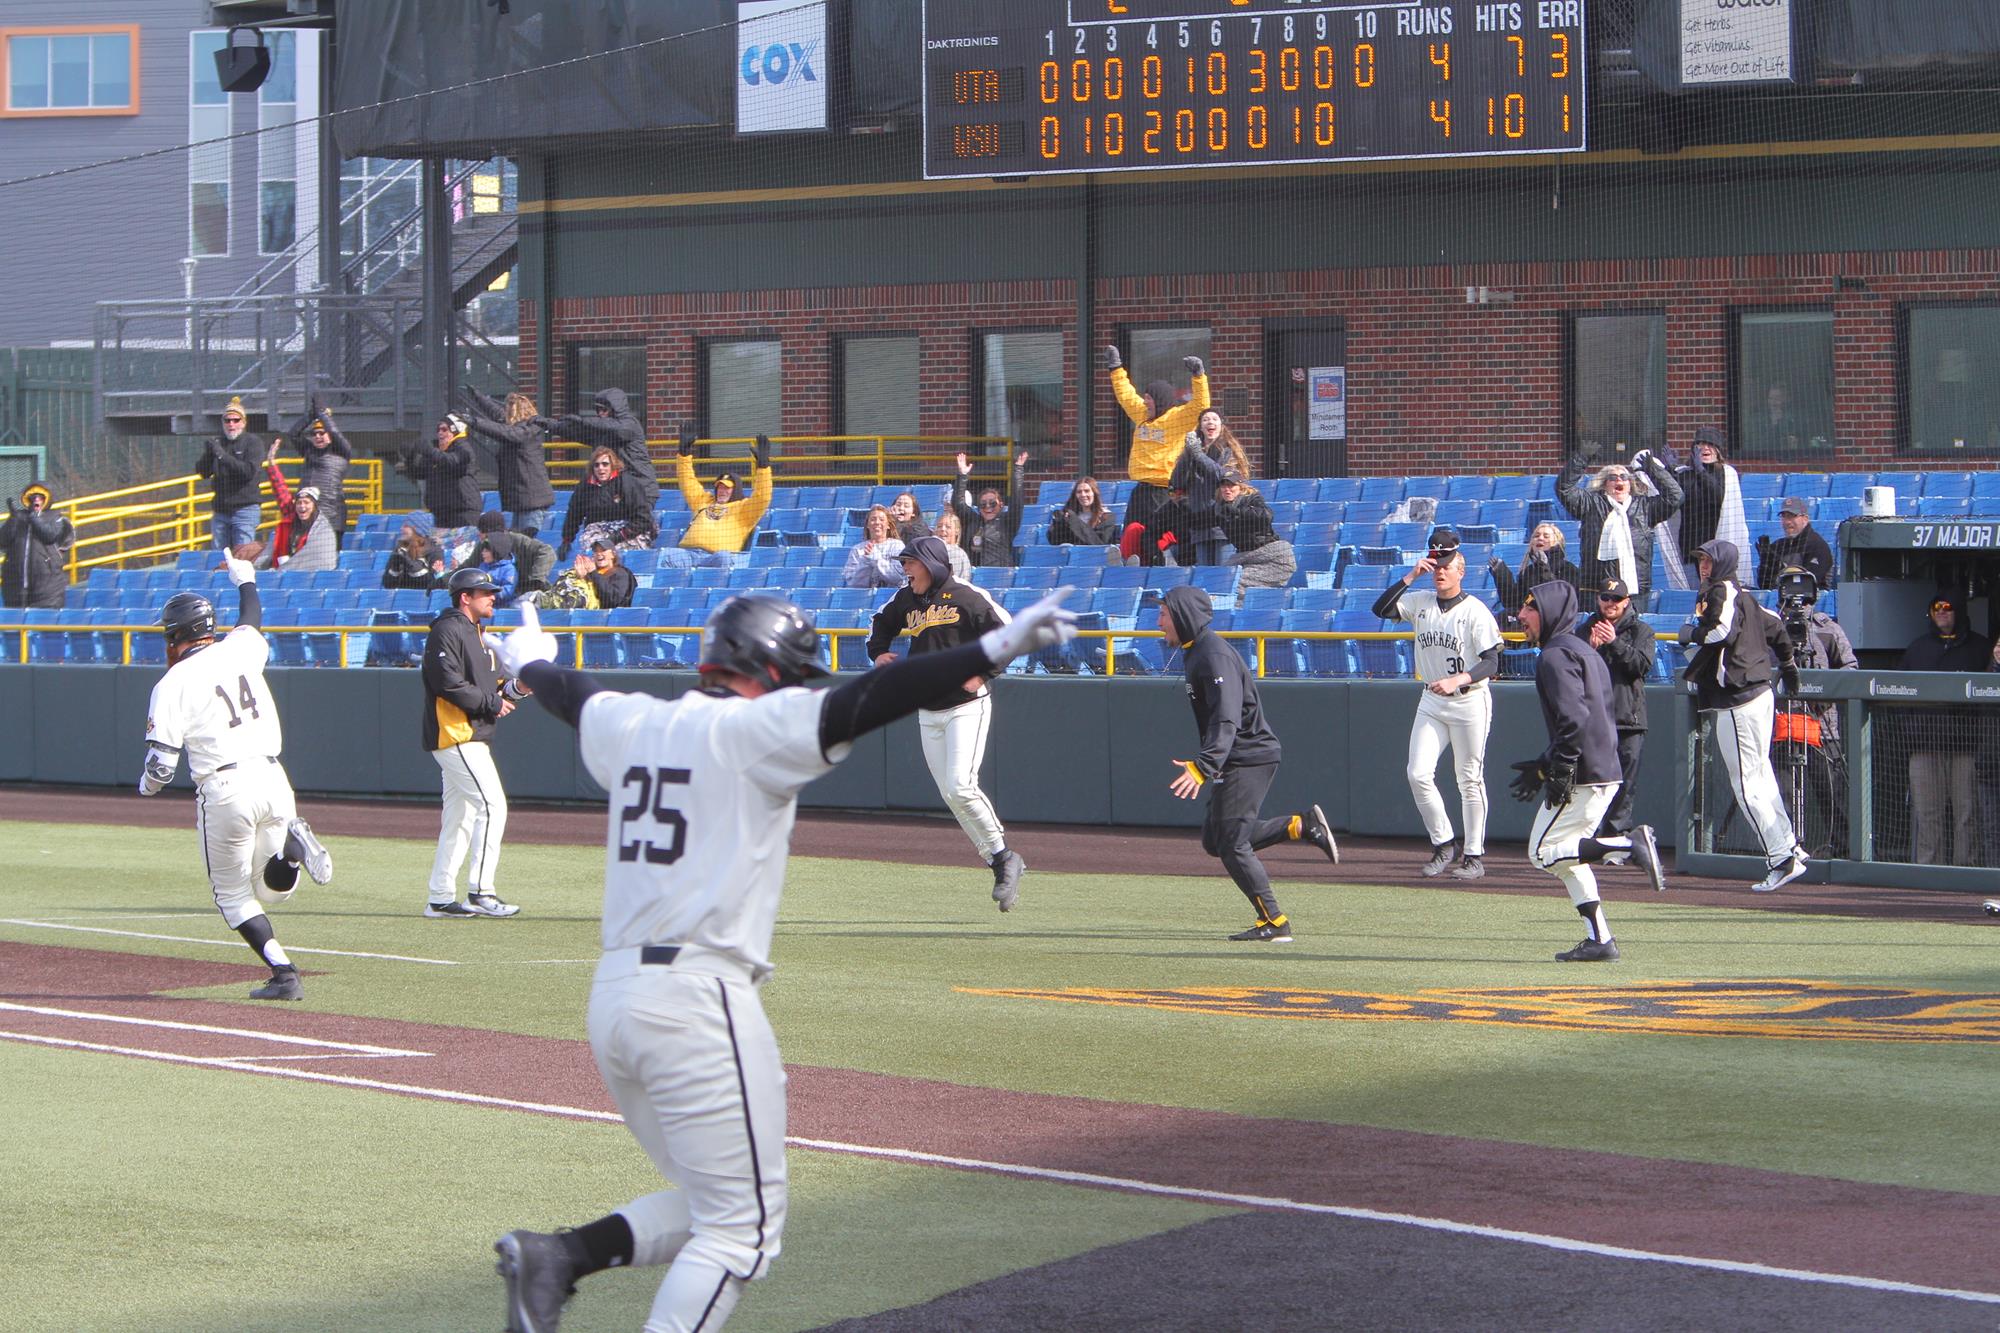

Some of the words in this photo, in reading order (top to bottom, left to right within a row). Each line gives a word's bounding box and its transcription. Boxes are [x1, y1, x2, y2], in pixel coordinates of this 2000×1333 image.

[1045, 30, 1054, 56] 1
[1074, 28, 1086, 54] 2
[1106, 26, 1117, 51] 3
[1146, 24, 1157, 49] 4
[1178, 22, 1190, 48] 5
[1210, 20, 1222, 46] 6
[1251, 18, 1262, 44] 7
[1283, 16, 1294, 42] 8
[1316, 14, 1326, 40] 9
[1355, 11, 1377, 38] 10
[1397, 6, 1452, 36] RUNS
[1476, 3, 1522, 32] HITS
[1538, 0, 1579, 29] ERR
[1685, 19, 1701, 32] Get
[927, 36, 999, 50] DAKTRONICS
[1685, 41, 1701, 54] Get
[741, 39, 817, 86] COX
[953, 69, 999, 104] UTA
[1040, 61, 1059, 104] 0
[1072, 59, 1091, 102] 0
[1104, 57, 1123, 100] 0
[1142, 55, 1162, 98] 0
[1187, 57, 1194, 93] 1
[1207, 52, 1227, 95] 0
[1249, 49, 1266, 93] 3
[1280, 48, 1300, 91] 0
[1314, 46, 1333, 89] 0
[1355, 43, 1374, 87] 0
[1430, 42, 1449, 81] 4
[1506, 36, 1523, 77] 7
[1551, 33, 1568, 78] 3
[1685, 64, 1701, 77] Get
[1704, 62, 1728, 75] More
[1730, 61, 1750, 74] Out
[1751, 57, 1763, 78] of
[953, 124, 1000, 158] WSU
[1040, 116, 1060, 158] 0
[1085, 117, 1092, 154] 1
[1104, 113, 1124, 155] 0
[1143, 111, 1162, 153] 2
[1175, 109, 1194, 152] 0
[1208, 107, 1227, 150] 0
[1248, 105, 1267, 149] 0
[1294, 106, 1301, 144] 1
[1315, 102, 1334, 146] 0
[1430, 99, 1450, 138] 4
[1488, 94, 1524, 138] 10
[1563, 94, 1569, 133] 1
[1912, 525, 1934, 547] 37
[1936, 525, 1992, 547] MAJOR
[1446, 656, 1465, 675] 30
[215, 674, 259, 728] 14
[618, 766, 692, 866] 25
